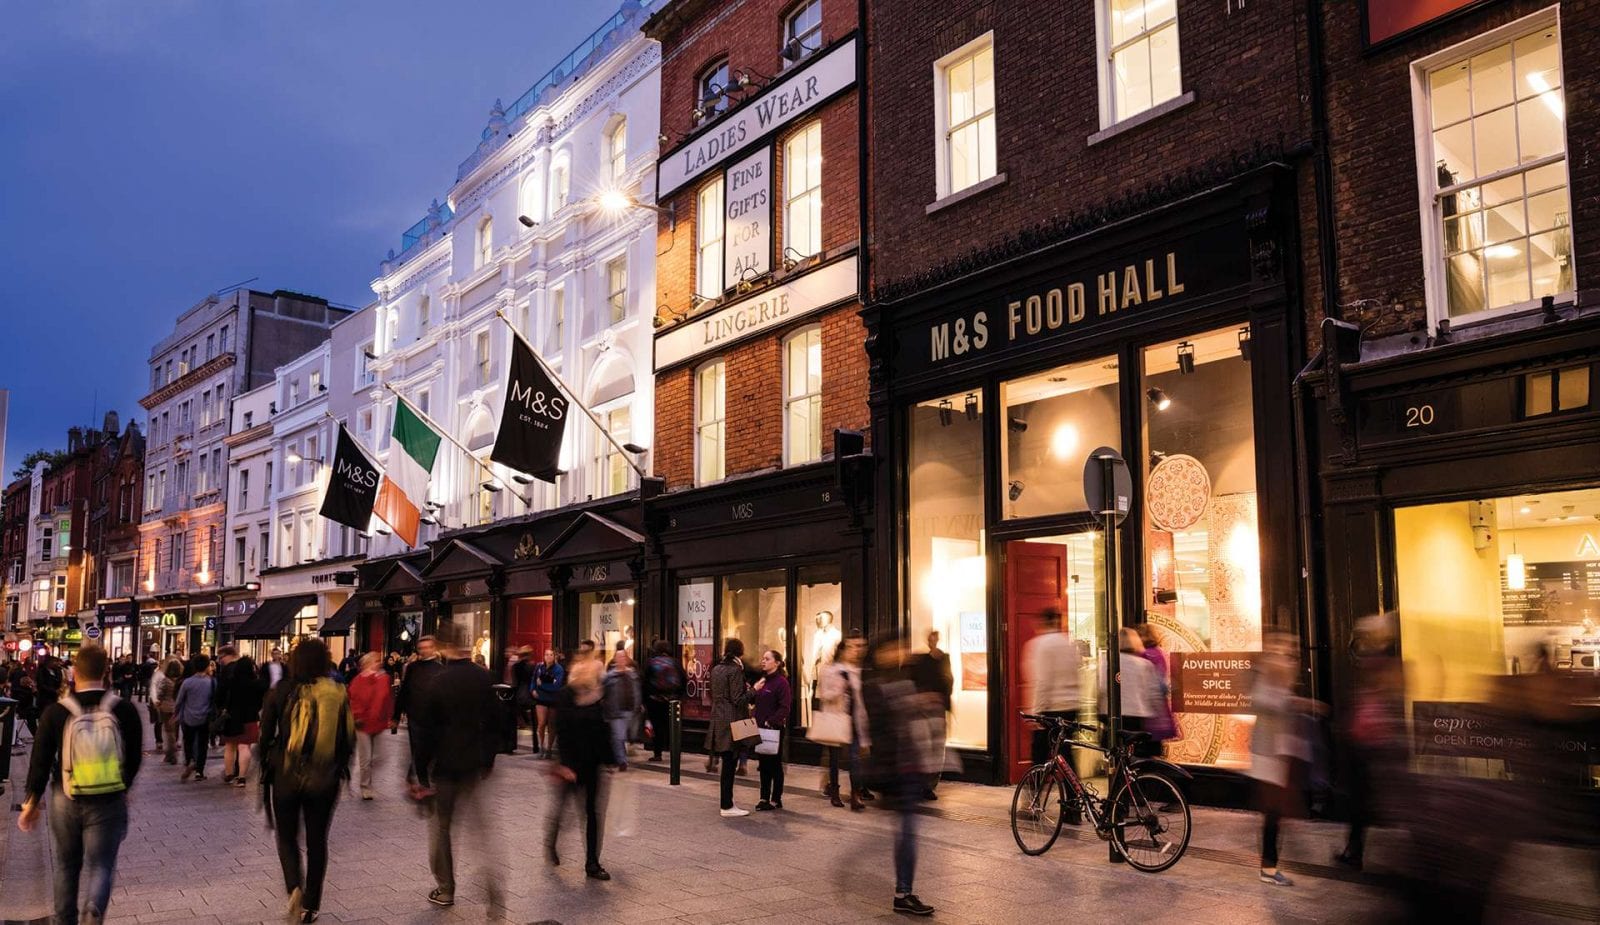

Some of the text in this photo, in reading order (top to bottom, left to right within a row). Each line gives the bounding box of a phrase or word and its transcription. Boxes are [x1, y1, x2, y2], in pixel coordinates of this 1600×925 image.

[684, 76, 819, 176] LADIES WEAR
[731, 162, 763, 191] FINE
[728, 188, 767, 220] GIFTS
[733, 221, 760, 246] FOR
[733, 252, 759, 277] ALL
[703, 293, 790, 345] LINGERIE
[931, 252, 1185, 362] M&S FOOD HALL
[511, 380, 564, 420] M&S
[1406, 405, 1434, 427] 20
[338, 458, 377, 488] M&S
[822, 492, 830, 502] 18
[732, 503, 753, 520] M&S
[687, 600, 706, 613] M&S
[1182, 660, 1252, 669] ADVENTURES
[687, 680, 710, 697] OFF
[1202, 680, 1231, 689] SPICE
[1434, 734, 1466, 745] OPEN
[1470, 736, 1503, 747] FROM
